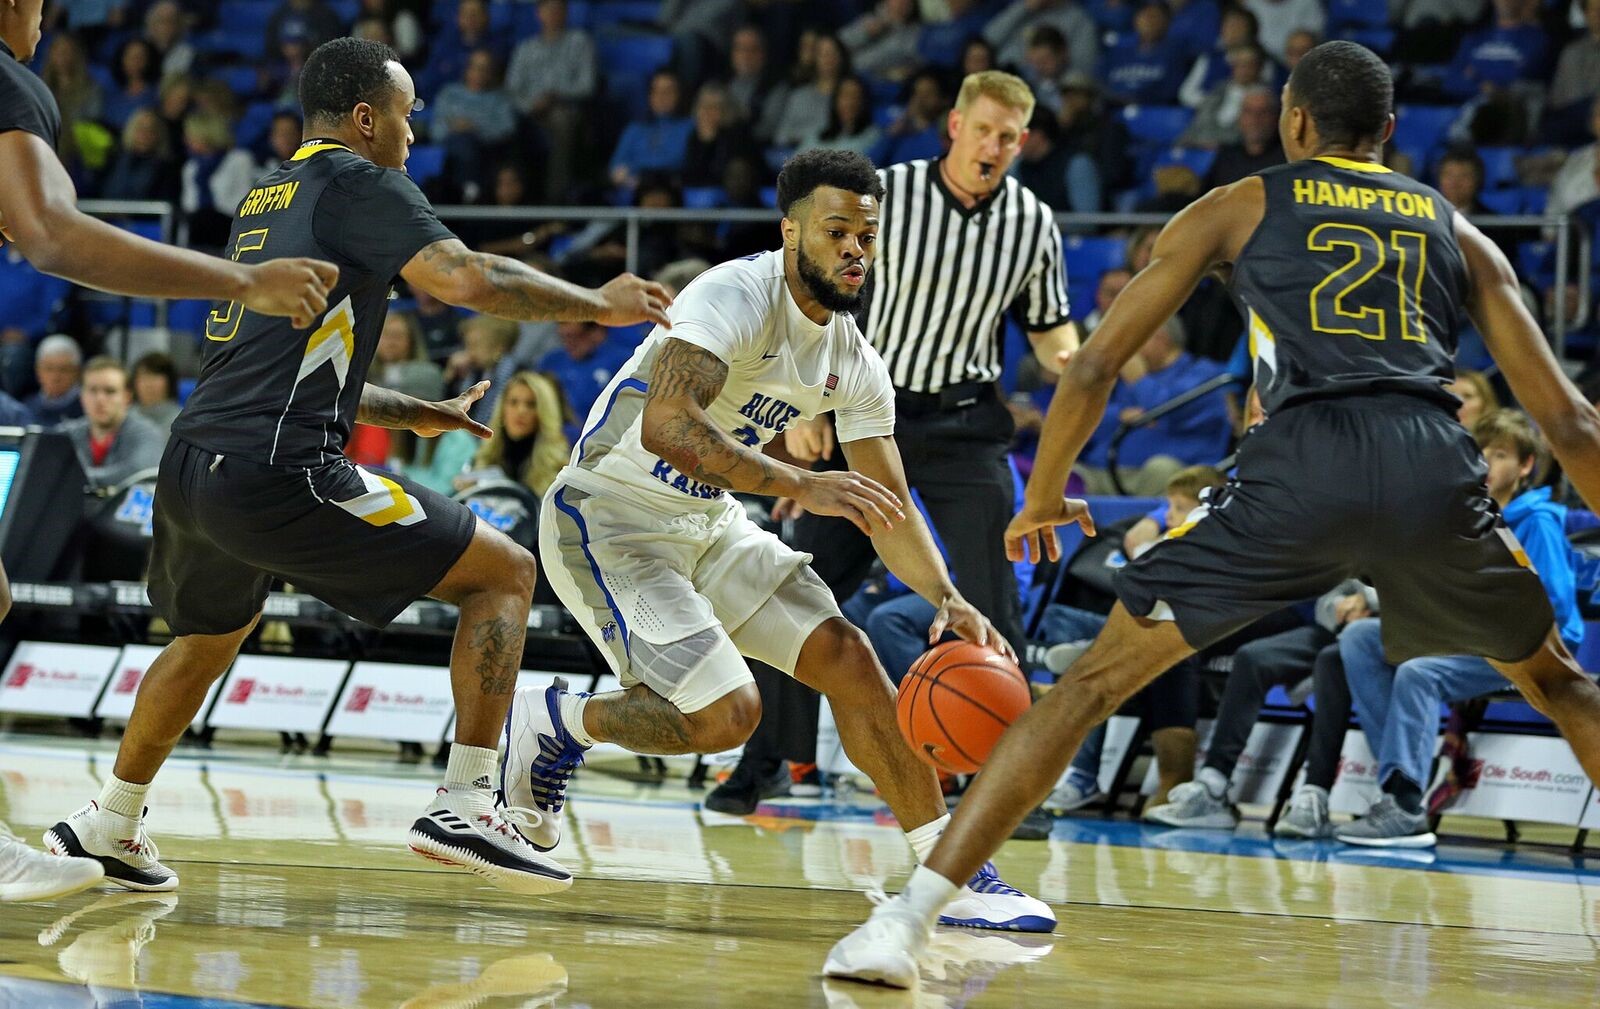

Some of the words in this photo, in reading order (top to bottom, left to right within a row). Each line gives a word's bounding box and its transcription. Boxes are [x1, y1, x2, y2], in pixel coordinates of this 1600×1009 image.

[239, 181, 300, 218] GRIFFIN
[1293, 179, 1437, 221] HAMPTON
[1307, 222, 1428, 344] 21
[737, 392, 801, 432] BLUE
[1484, 765, 1506, 779] Ole
